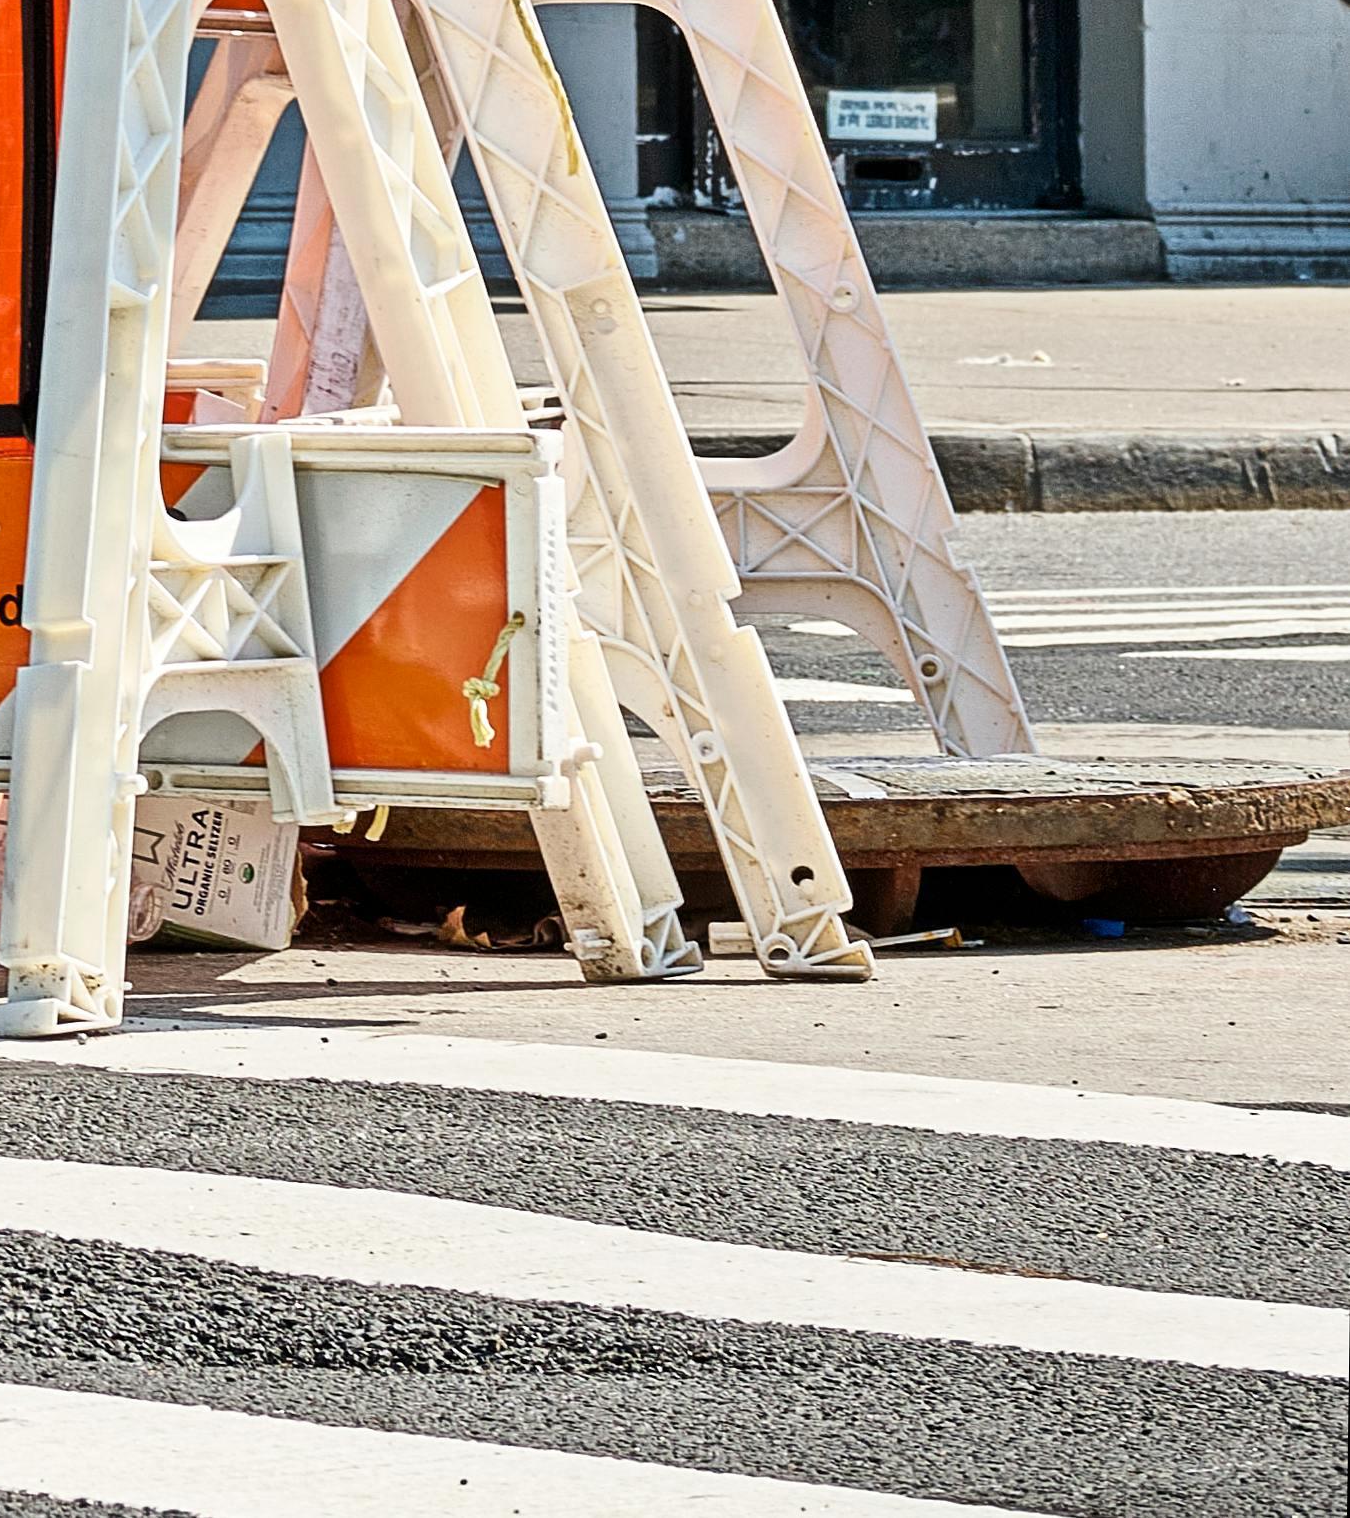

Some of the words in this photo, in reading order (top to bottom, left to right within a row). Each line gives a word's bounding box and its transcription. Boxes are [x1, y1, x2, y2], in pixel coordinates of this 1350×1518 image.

[171, 809, 211, 910] ULTRA
[194, 860, 215, 916] ORGANIC
[210, 811, 224, 859] SELTZER
